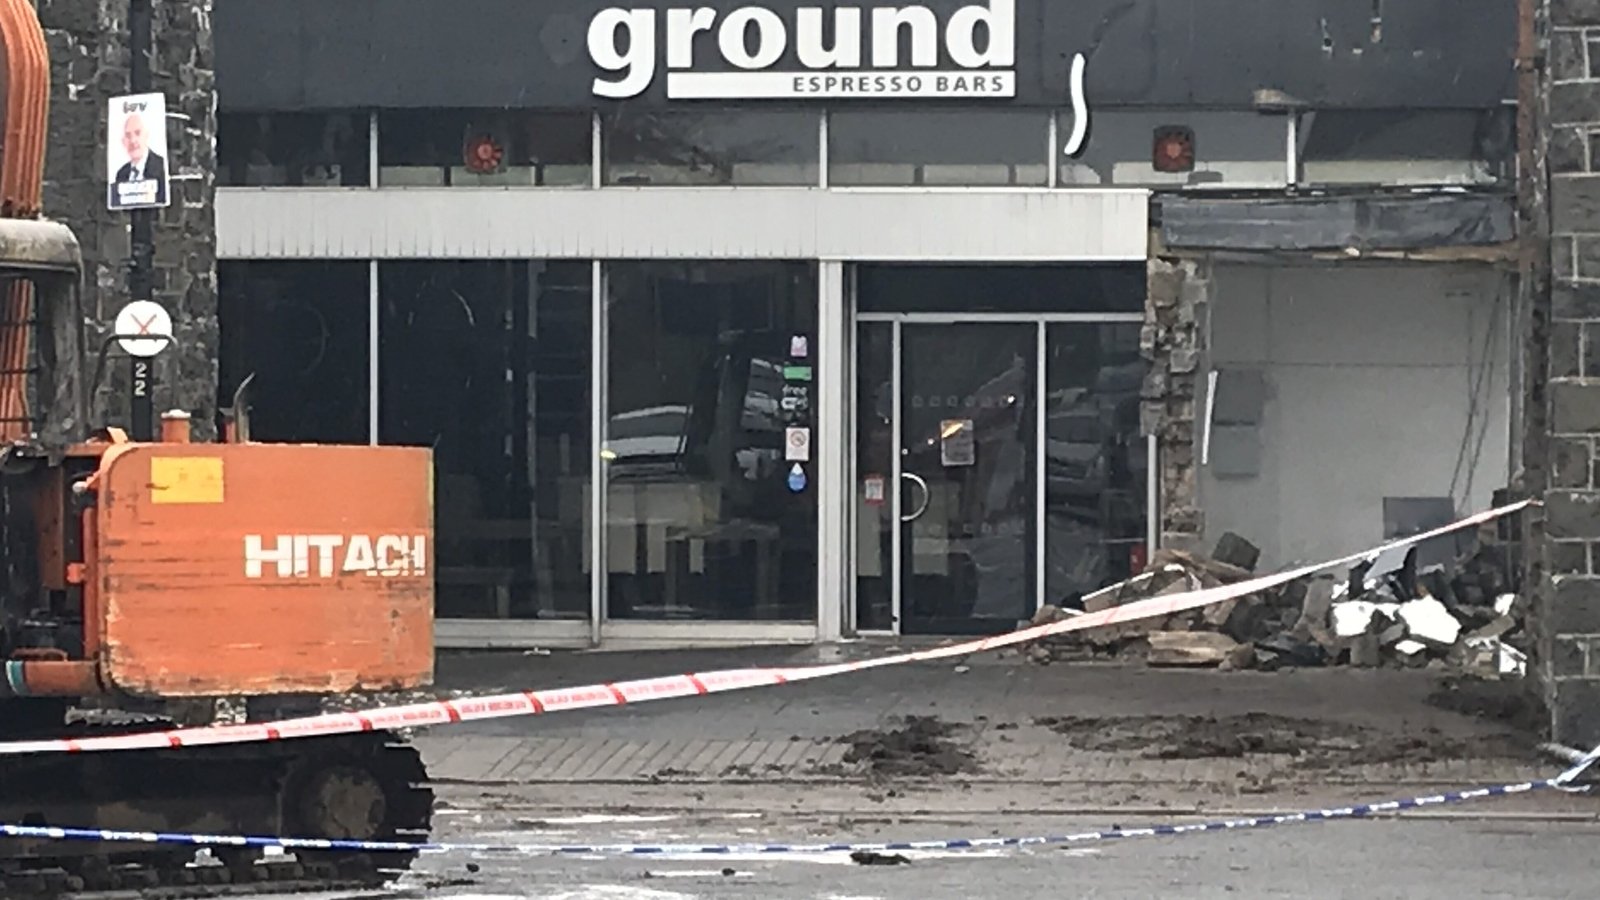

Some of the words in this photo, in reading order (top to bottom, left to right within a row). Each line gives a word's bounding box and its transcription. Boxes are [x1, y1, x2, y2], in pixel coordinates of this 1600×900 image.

[587, 0, 1015, 98] ground
[793, 75, 922, 93] ESPRESSO
[936, 75, 1004, 93] BARS
